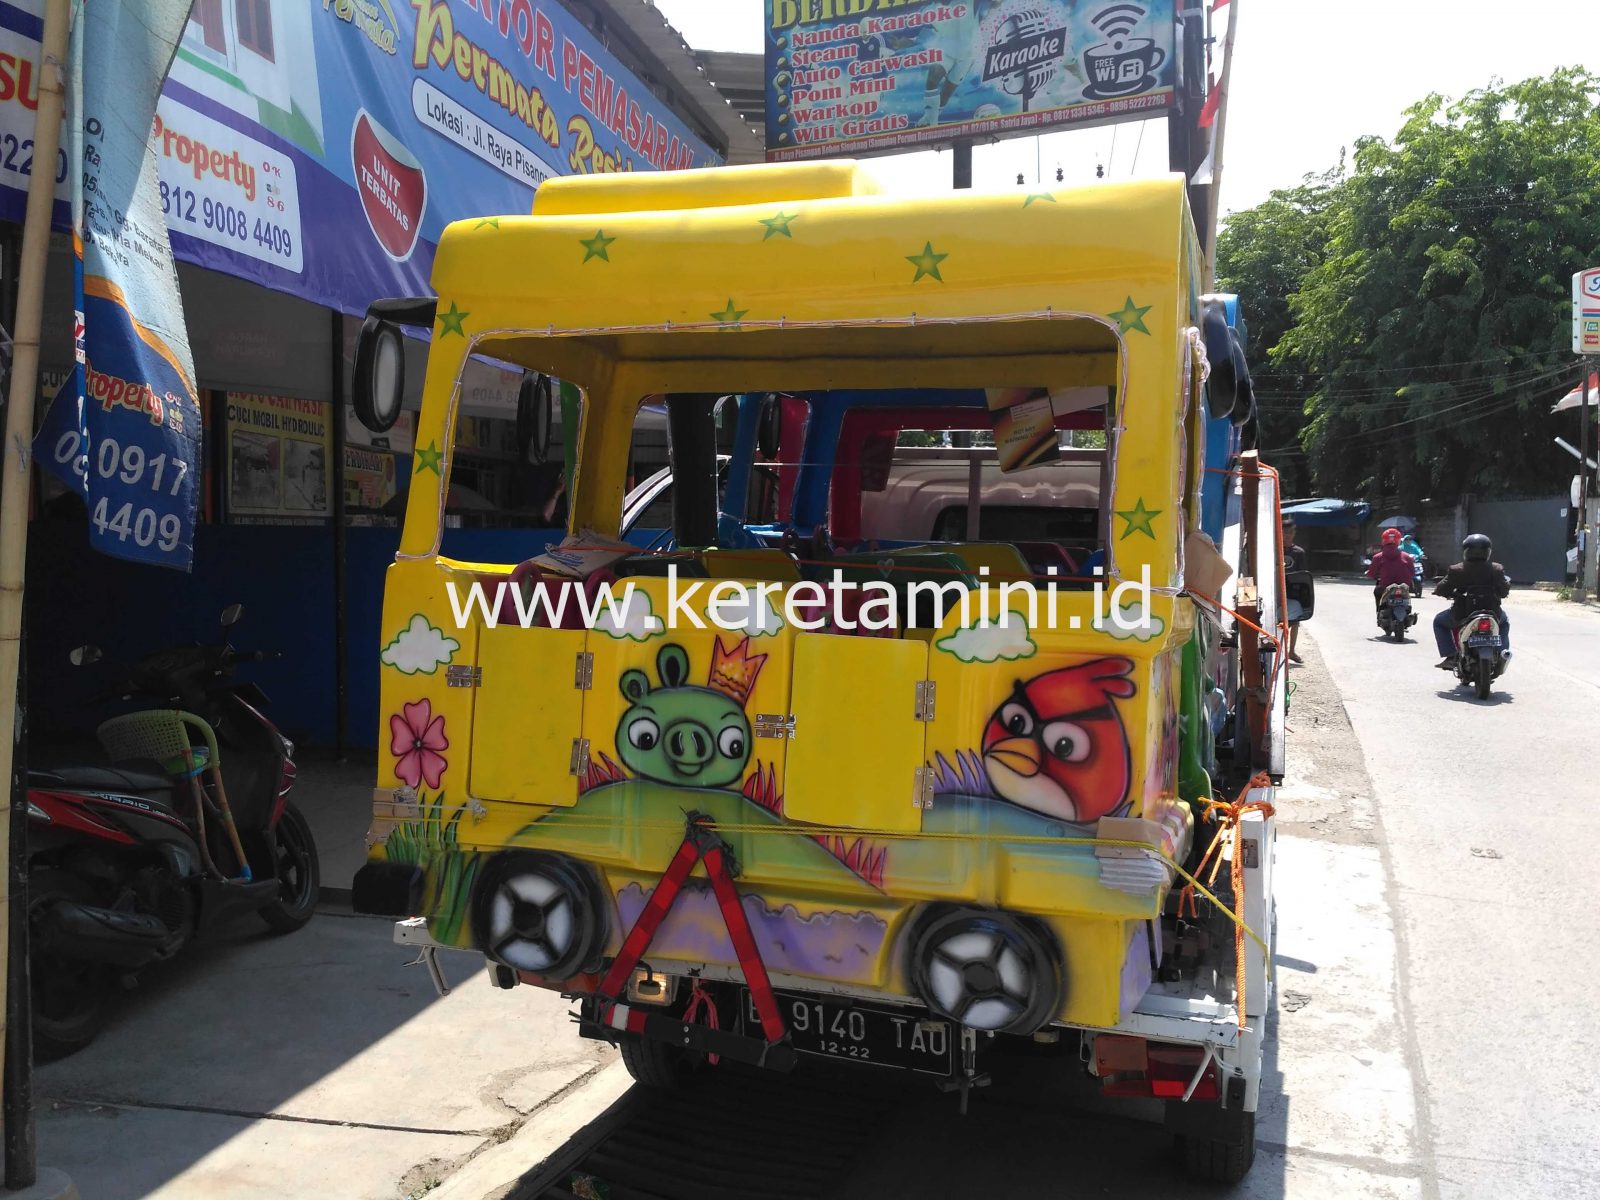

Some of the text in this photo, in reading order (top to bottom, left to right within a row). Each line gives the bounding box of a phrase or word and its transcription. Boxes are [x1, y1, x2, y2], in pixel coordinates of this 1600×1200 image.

[792, 24, 860, 48] Nanda
[867, 4, 968, 34] Karaoke
[411, 0, 560, 148] Permata
[792, 43, 859, 67] Steam
[792, 48, 944, 87] Auto Carwash
[988, 36, 1060, 75] Karaoke
[1094, 57, 1115, 69] FREE
[792, 75, 897, 105] Pom Mini
[426, 92, 464, 138] Lokasi
[473, 129, 486, 151] Jl.
[488, 134, 514, 168] Raya
[793, 100, 878, 126] Warkop
[842, 113, 908, 137] Gratis
[154, 113, 257, 202] Property
[373, 155, 401, 197] UNIT
[361, 164, 409, 231] TERBATAS
[203, 197, 249, 241] 9008
[253, 216, 292, 258] 4409
[227, 404, 251, 424] CUCI
[253, 410, 280, 430] MOBIL
[98, 438, 188, 496] 0917
[92, 496, 181, 552] 4409
[792, 1001, 866, 1042] 9140
